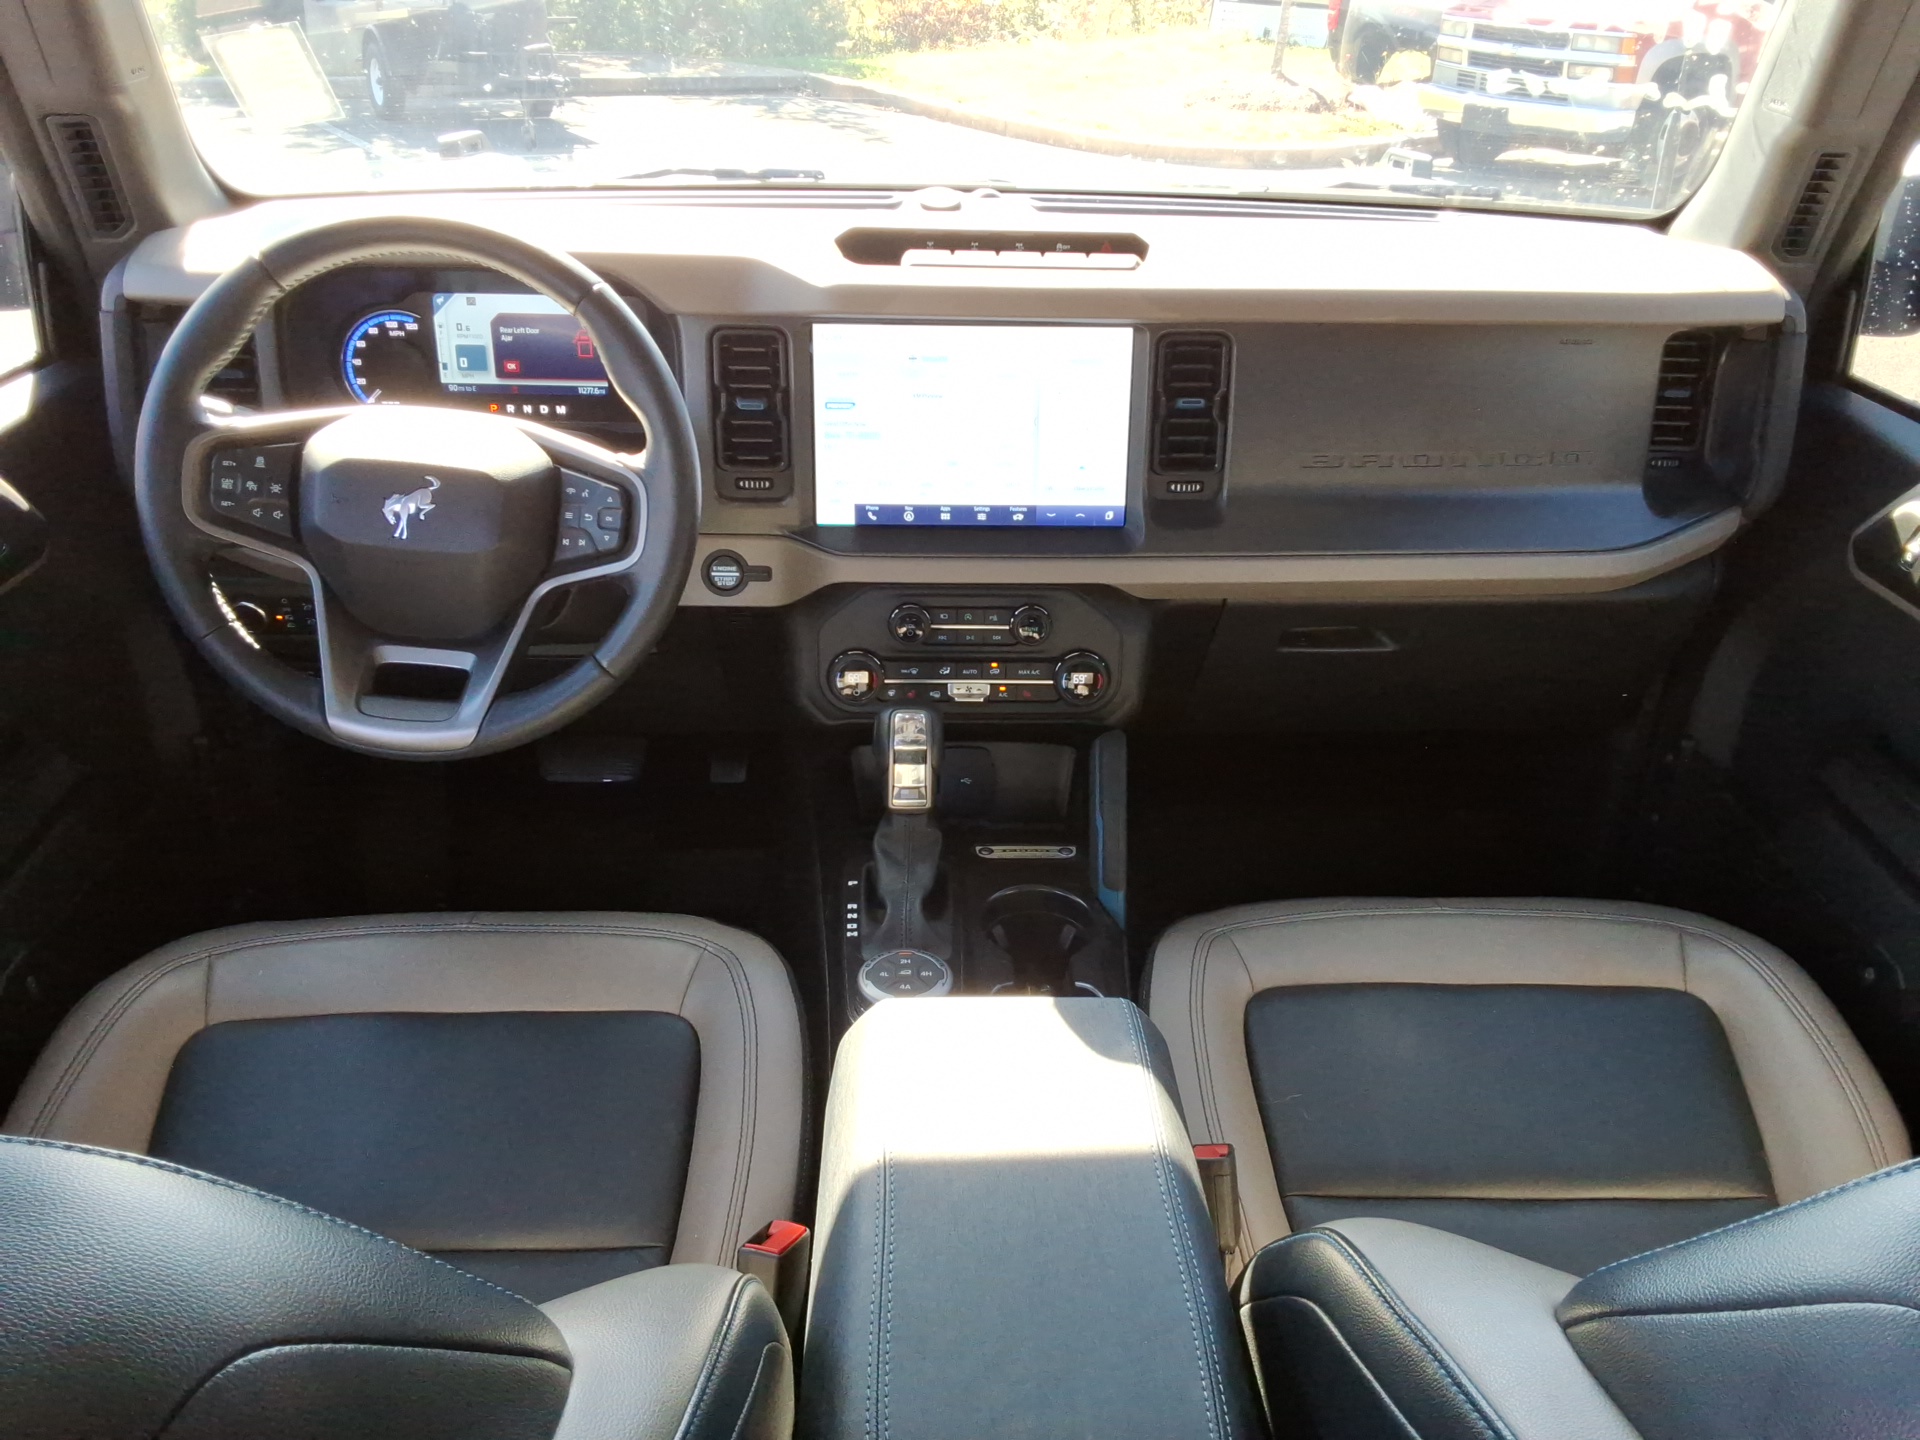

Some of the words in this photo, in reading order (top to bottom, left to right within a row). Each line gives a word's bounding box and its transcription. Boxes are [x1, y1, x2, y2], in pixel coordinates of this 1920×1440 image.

[499, 326, 513, 334] Rear
[513, 326, 525, 334] Left
[501, 334, 513, 342] Ajar
[507, 362, 517, 370] OK
